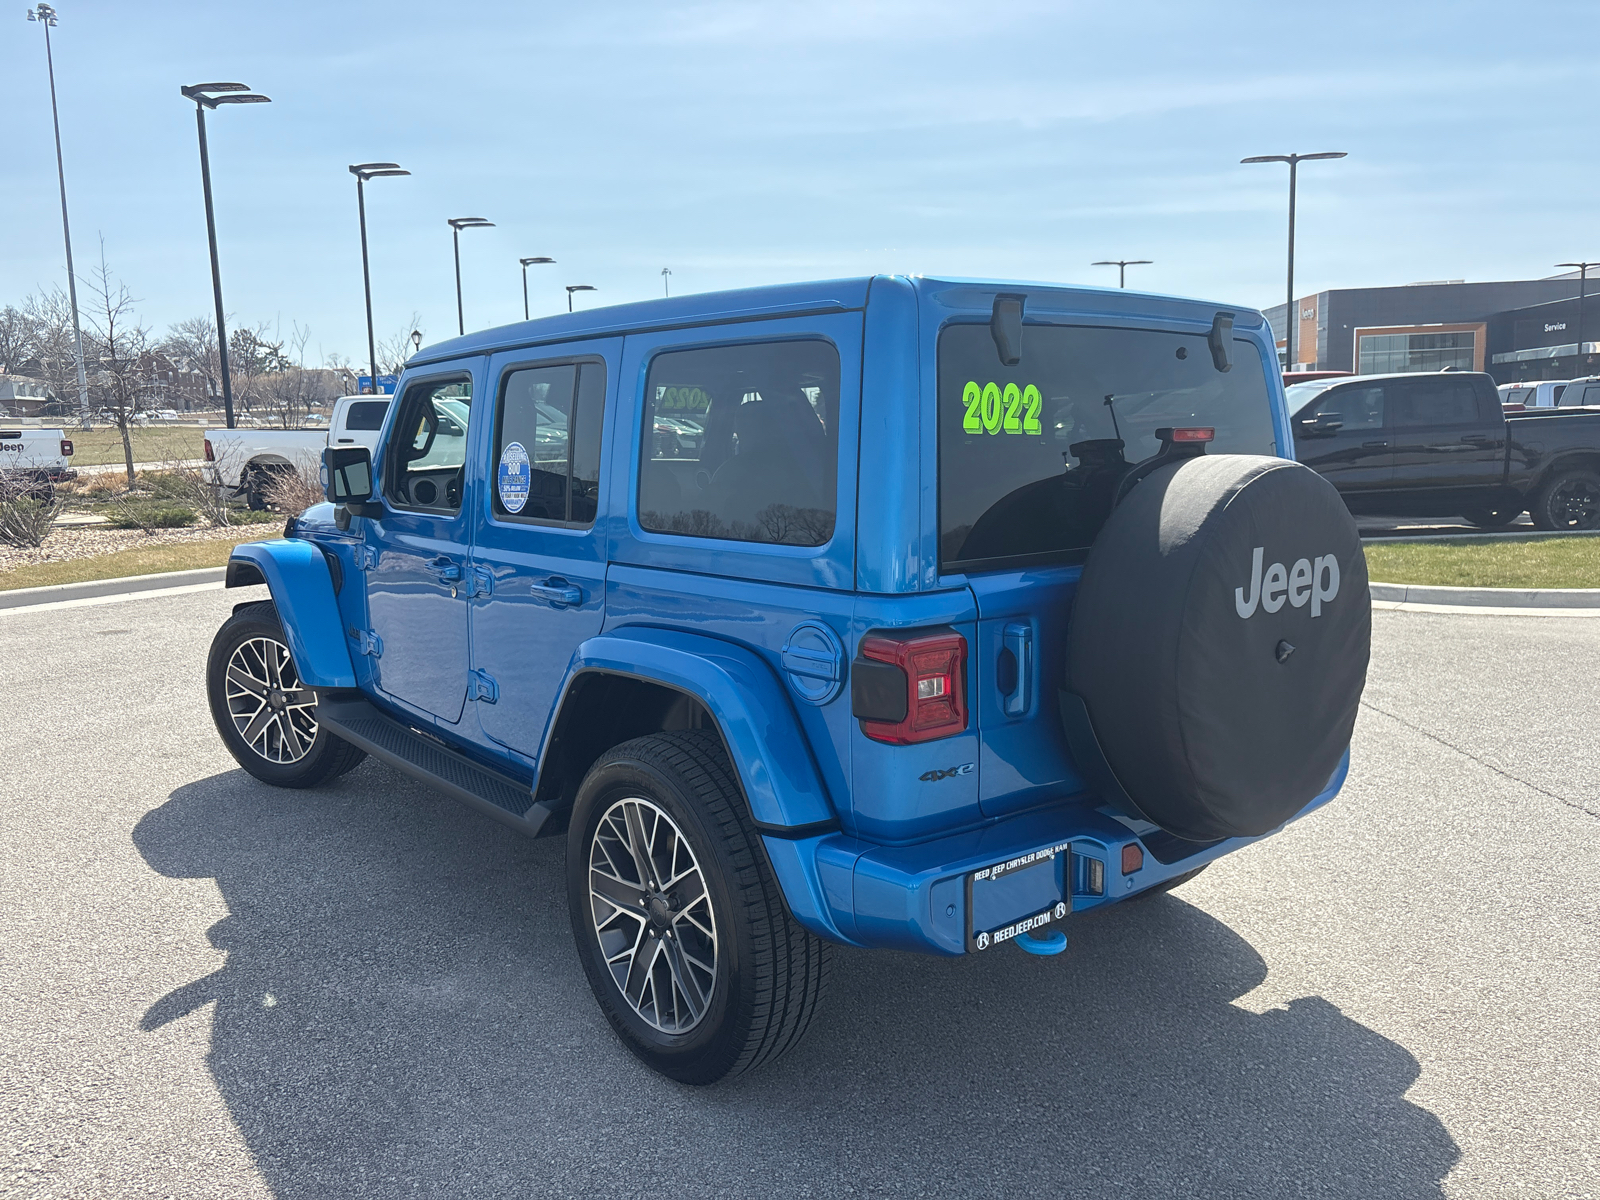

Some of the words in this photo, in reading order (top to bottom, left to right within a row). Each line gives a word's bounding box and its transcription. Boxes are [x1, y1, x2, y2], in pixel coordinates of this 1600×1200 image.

[1544, 321, 1567, 332] Service
[962, 381, 1043, 436] 2022
[1235, 547, 1340, 619] Jeep
[974, 868, 990, 882] REED
[991, 863, 1006, 875] JEEP
[1006, 852, 1036, 870] CHRYSLER
[1036, 847, 1054, 860] DODGE
[1054, 843, 1068, 853] RAM
[994, 911, 1051, 944] REEDJEEP.COM
